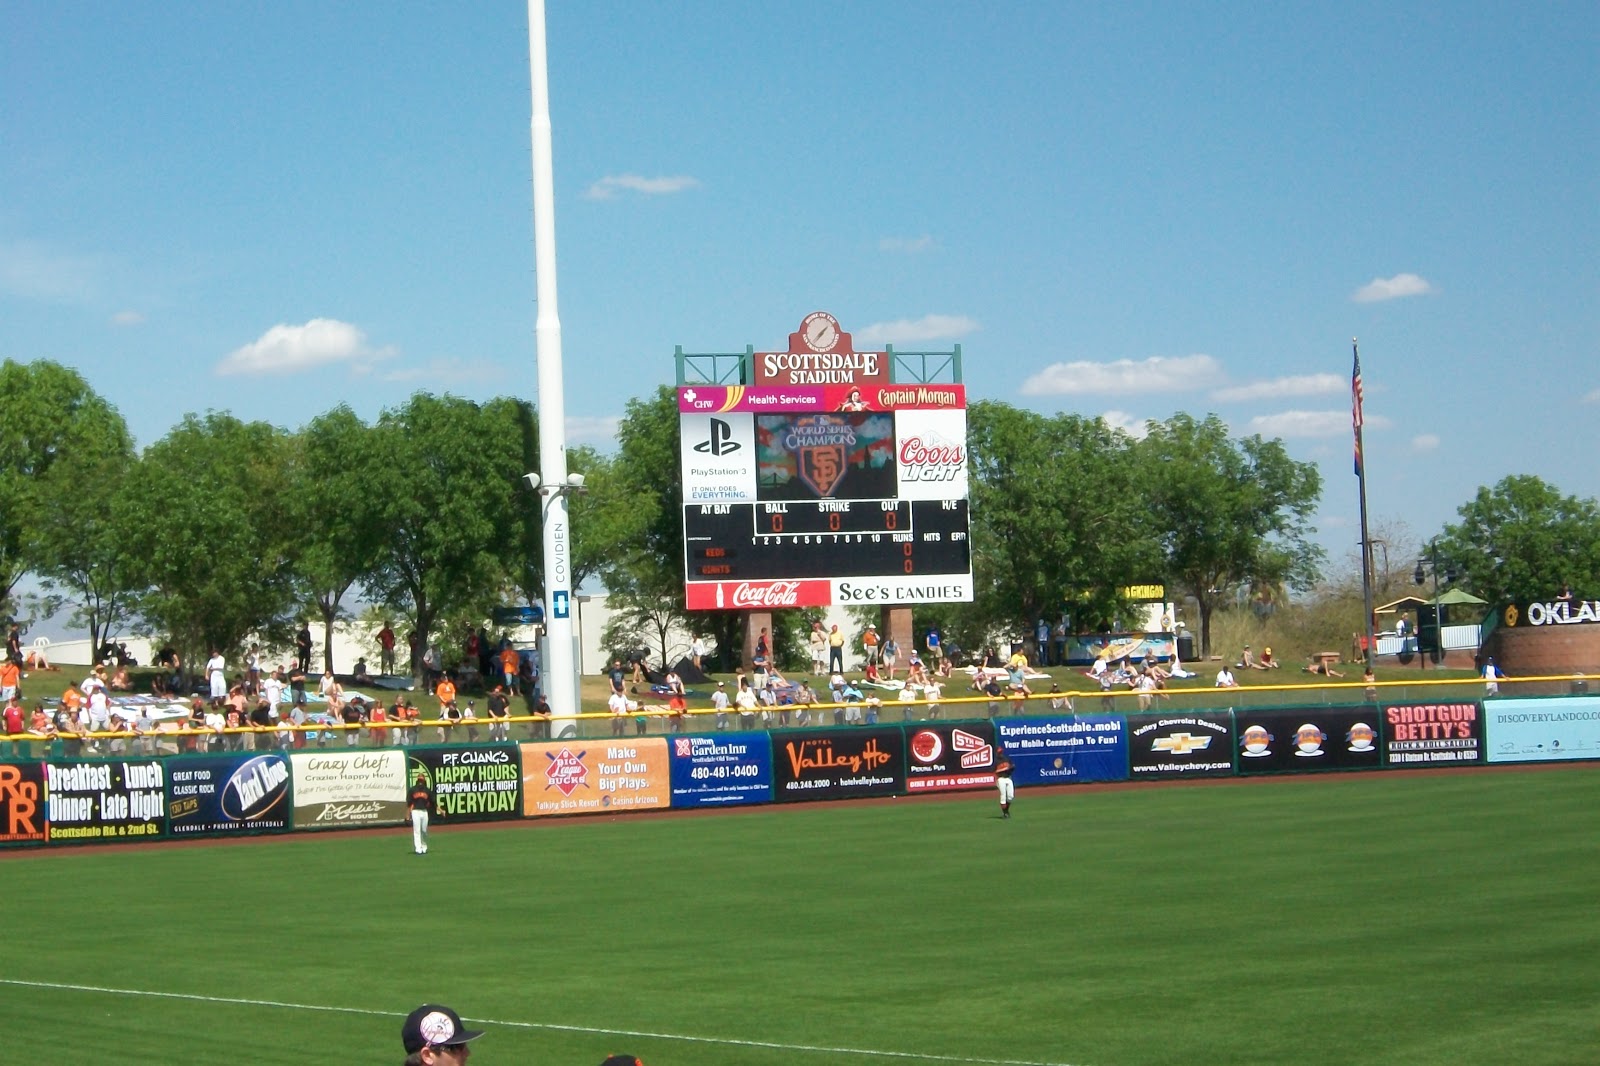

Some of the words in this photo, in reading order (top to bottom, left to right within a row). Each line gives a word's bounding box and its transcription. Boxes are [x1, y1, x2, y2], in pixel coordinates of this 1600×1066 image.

[764, 354, 879, 377] SCOTTSDALE
[790, 370, 854, 384] STADIUM
[748, 395, 777, 404] Health
[780, 395, 816, 404] Services
[878, 388, 915, 407] Captain
[915, 388, 956, 406] Morgan
[792, 426, 825, 436] WORLD
[826, 425, 855, 434] SERIES
[786, 433, 856, 449] CHAMPIONS
[899, 436, 964, 467] Coors
[691, 468, 738, 477] PlayStation
[901, 465, 961, 482] LIGHT
[692, 491, 748, 499] EVERYTHING.
[701, 505, 713, 514] AT
[714, 504, 731, 514] BAT
[765, 503, 788, 513] BALL
[818, 501, 850, 512] STRIKE
[881, 501, 899, 511] OUT
[942, 500, 957, 510] H/E
[772, 514, 783, 532] 0
[830, 512, 840, 531] 0
[886, 512, 896, 530] 0
[752, 537, 756, 545] 1
[763, 537, 769, 545] 2
[776, 536, 781, 544] 3
[793, 536, 798, 544] 4
[804, 536, 810, 544] 5
[816, 535, 821, 543] 6
[833, 535, 838, 543] 7
[845, 534, 850, 543] 8
[857, 534, 862, 543] 9
[871, 534, 881, 542] 10
[893, 533, 914, 542] RUNS
[924, 532, 941, 542] HITS
[554, 523, 565, 583] COVIDIEN
[904, 542, 912, 556] 0
[904, 559, 912, 573] 0
[839, 583, 889, 601] See's
[896, 585, 963, 600] CANDIES
[1387, 705, 1476, 724] SHOTGUN
[1000, 721, 1121, 736] ExperienceScottsdale.mobi
[1133, 723, 1157, 737] Valley
[1158, 718, 1196, 726] Chevrolet
[1197, 719, 1228, 734] Dealers
[1395, 721, 1471, 740] BETTY'S
[691, 738, 714, 746] Hilton
[956, 735, 974, 747] 5TH
[1004, 741, 1020, 749] Your
[1022, 739, 1044, 748] Mobile
[1046, 738, 1084, 747] Connection
[1086, 737, 1096, 745] To
[1098, 736, 1118, 744] Fun!
[1392, 742, 1413, 750] ROCK
[607, 747, 636, 759] Make
[692, 745, 728, 756] Garden
[729, 743, 746, 754] Inn
[308, 758, 348, 773] Crazy
[354, 754, 390, 772] Chef!
[786, 741, 862, 779] Valley
[862, 738, 891, 771] Ho
[963, 750, 989, 765] WINE
[436, 765, 475, 783] HAPPY
[479, 764, 517, 781] HOURS
[552, 765, 582, 778] League
[598, 762, 621, 775] Your
[624, 762, 646, 774] Own
[691, 765, 758, 779] 480-481-0400
[1040, 767, 1077, 777] Scottsdale
[1133, 762, 1231, 772] www.Valleychevy.com
[47, 763, 111, 792] Breakfast
[123, 761, 163, 789] Lunch
[173, 771, 192, 781] GREAT
[194, 771, 211, 780] FOOD
[548, 777, 586, 785] BUCKS
[840, 776, 893, 786] hotelvalleyho.com
[957, 776, 994, 784] GOLDWATER
[173, 785, 198, 795] CLASSIC
[199, 784, 215, 794] ROCK
[231, 766, 265, 811] Yard
[436, 783, 470, 793] 3PM-6PM
[472, 782, 477, 791] &
[478, 781, 495, 791] LATE
[496, 780, 517, 790] NIGHT
[600, 778, 616, 791] Big
[619, 777, 649, 790] Plays.
[49, 793, 92, 822] Dinner
[101, 792, 128, 820] Late
[130, 790, 164, 821] Night
[436, 791, 517, 815] EVERYDAY
[537, 801, 559, 810] Talking
[561, 800, 577, 809] Stick
[579, 799, 599, 807] Resort
[612, 797, 633, 806] Casino
[634, 795, 658, 804] Arizona
[334, 801, 385, 819] Eddie's
[50, 826, 101, 839] Scottsdale
[103, 825, 117, 836] Rd.
[119, 826, 125, 835] &
[128, 824, 145, 835] 2nd
[147, 823, 159, 834] St.
